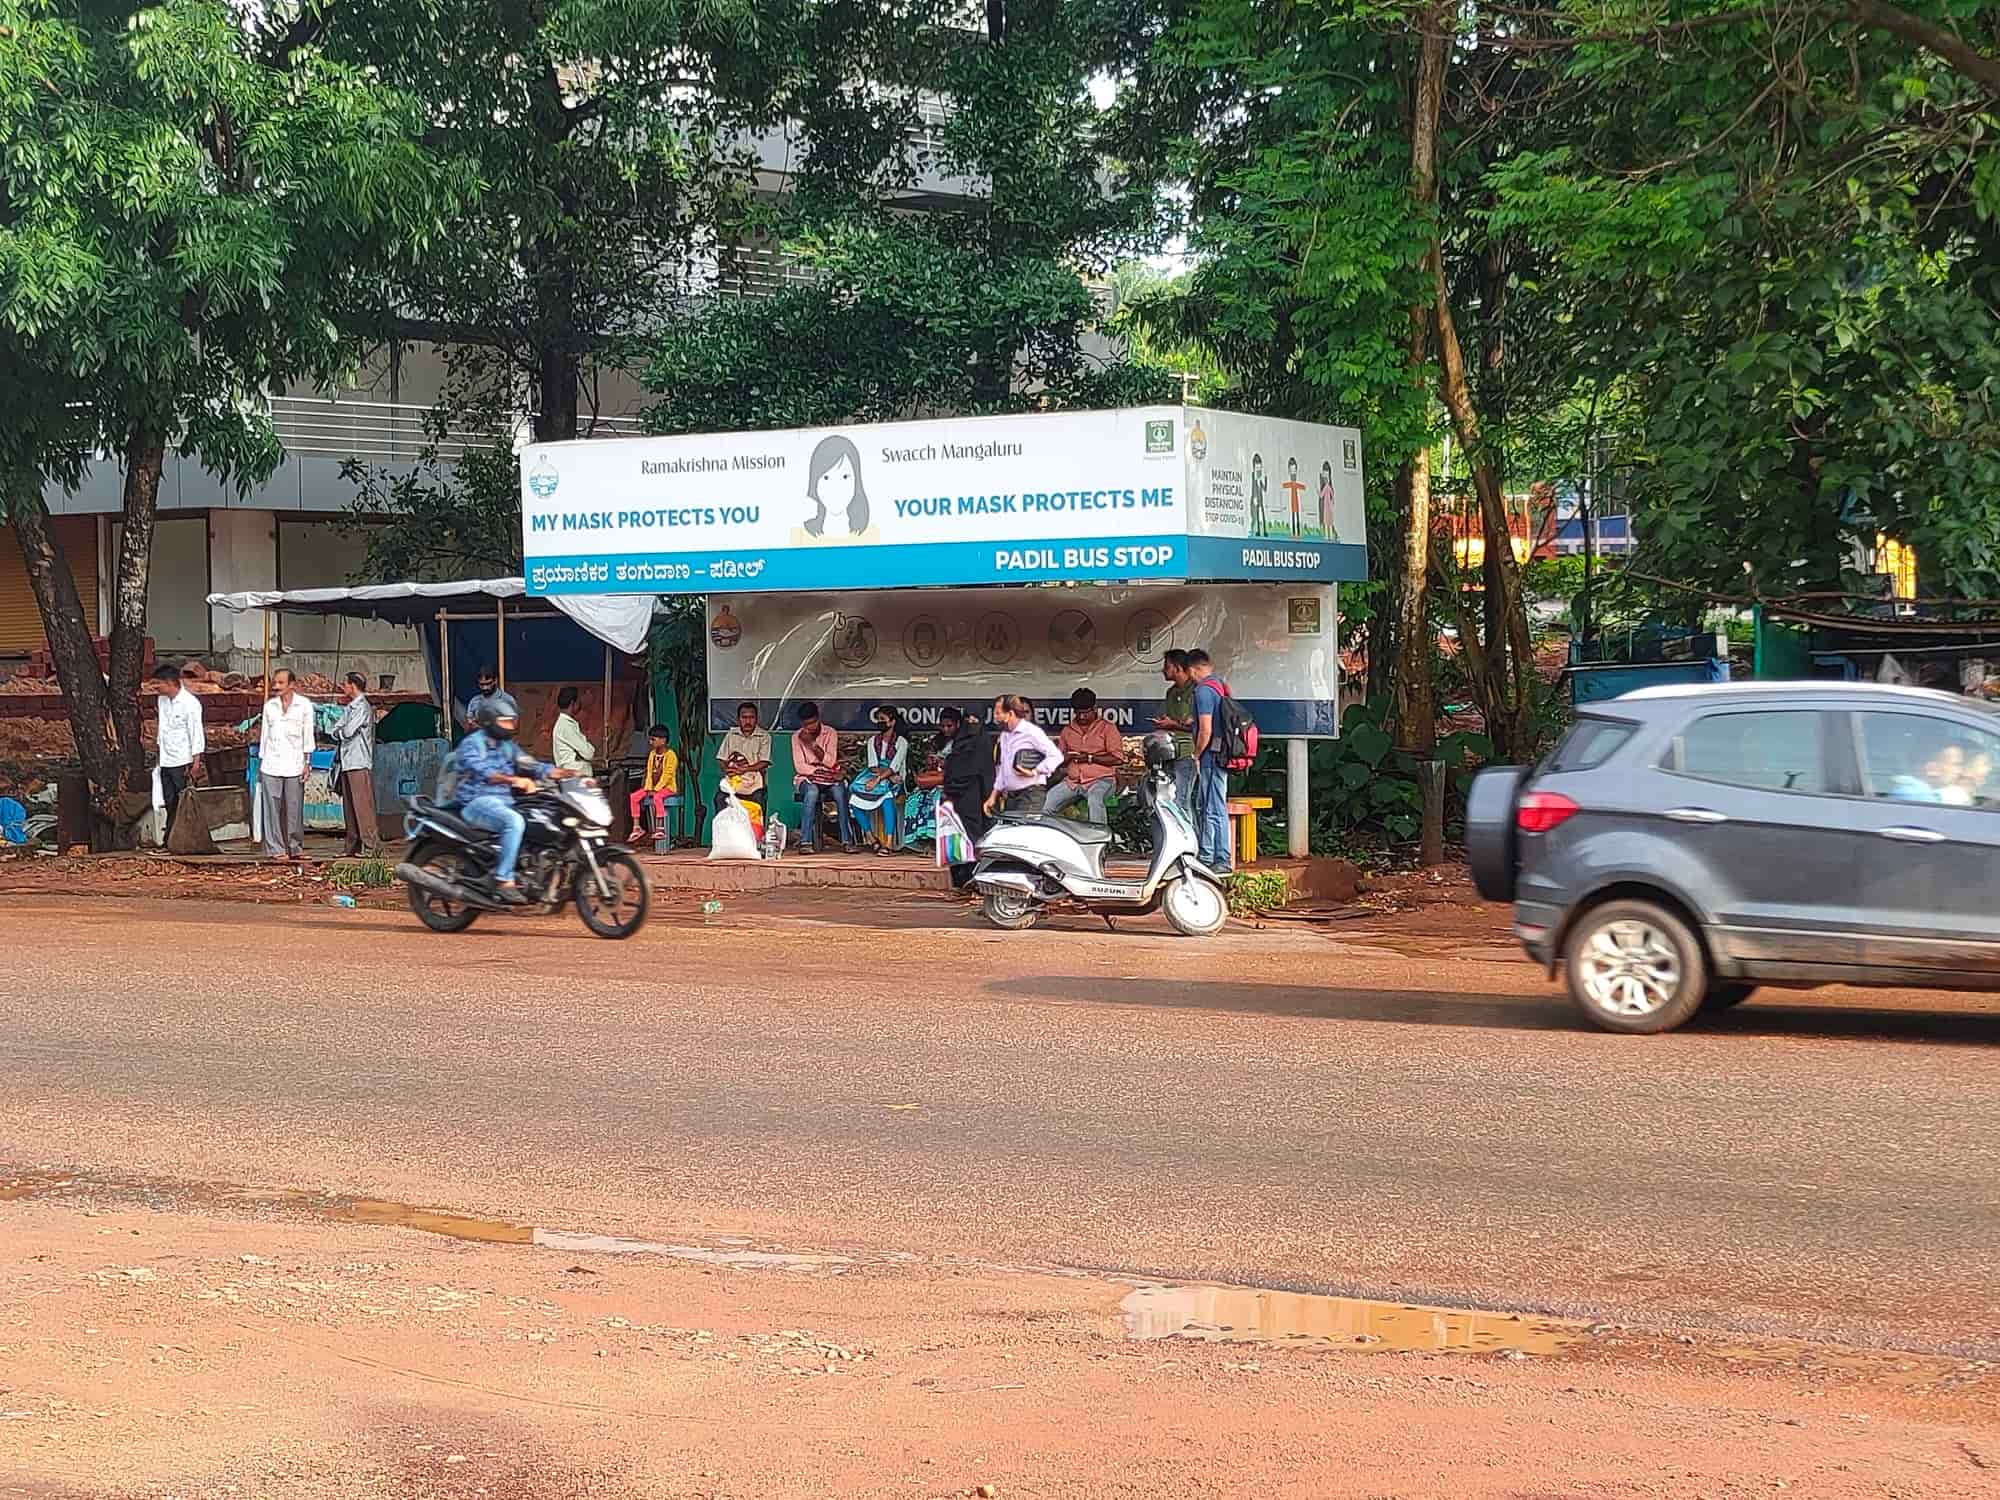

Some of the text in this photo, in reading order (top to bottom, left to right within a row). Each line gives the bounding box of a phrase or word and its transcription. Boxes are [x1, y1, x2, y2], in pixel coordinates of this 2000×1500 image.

[881, 440, 1023, 463] Swacch Mangaluru
[641, 454, 785, 474] Ramakrishna Mission
[1212, 483, 1244, 497] PHYSICAL
[894, 487, 1173, 517] YOUR MASK PROTECTS ME
[532, 505, 760, 531] MY MASK PROTECTS YOU
[995, 546, 1173, 570] PADIL BUS STOP
[1242, 549, 1321, 569] PADIL BUS STOP
[1091, 886, 1126, 895] SUZUKI
